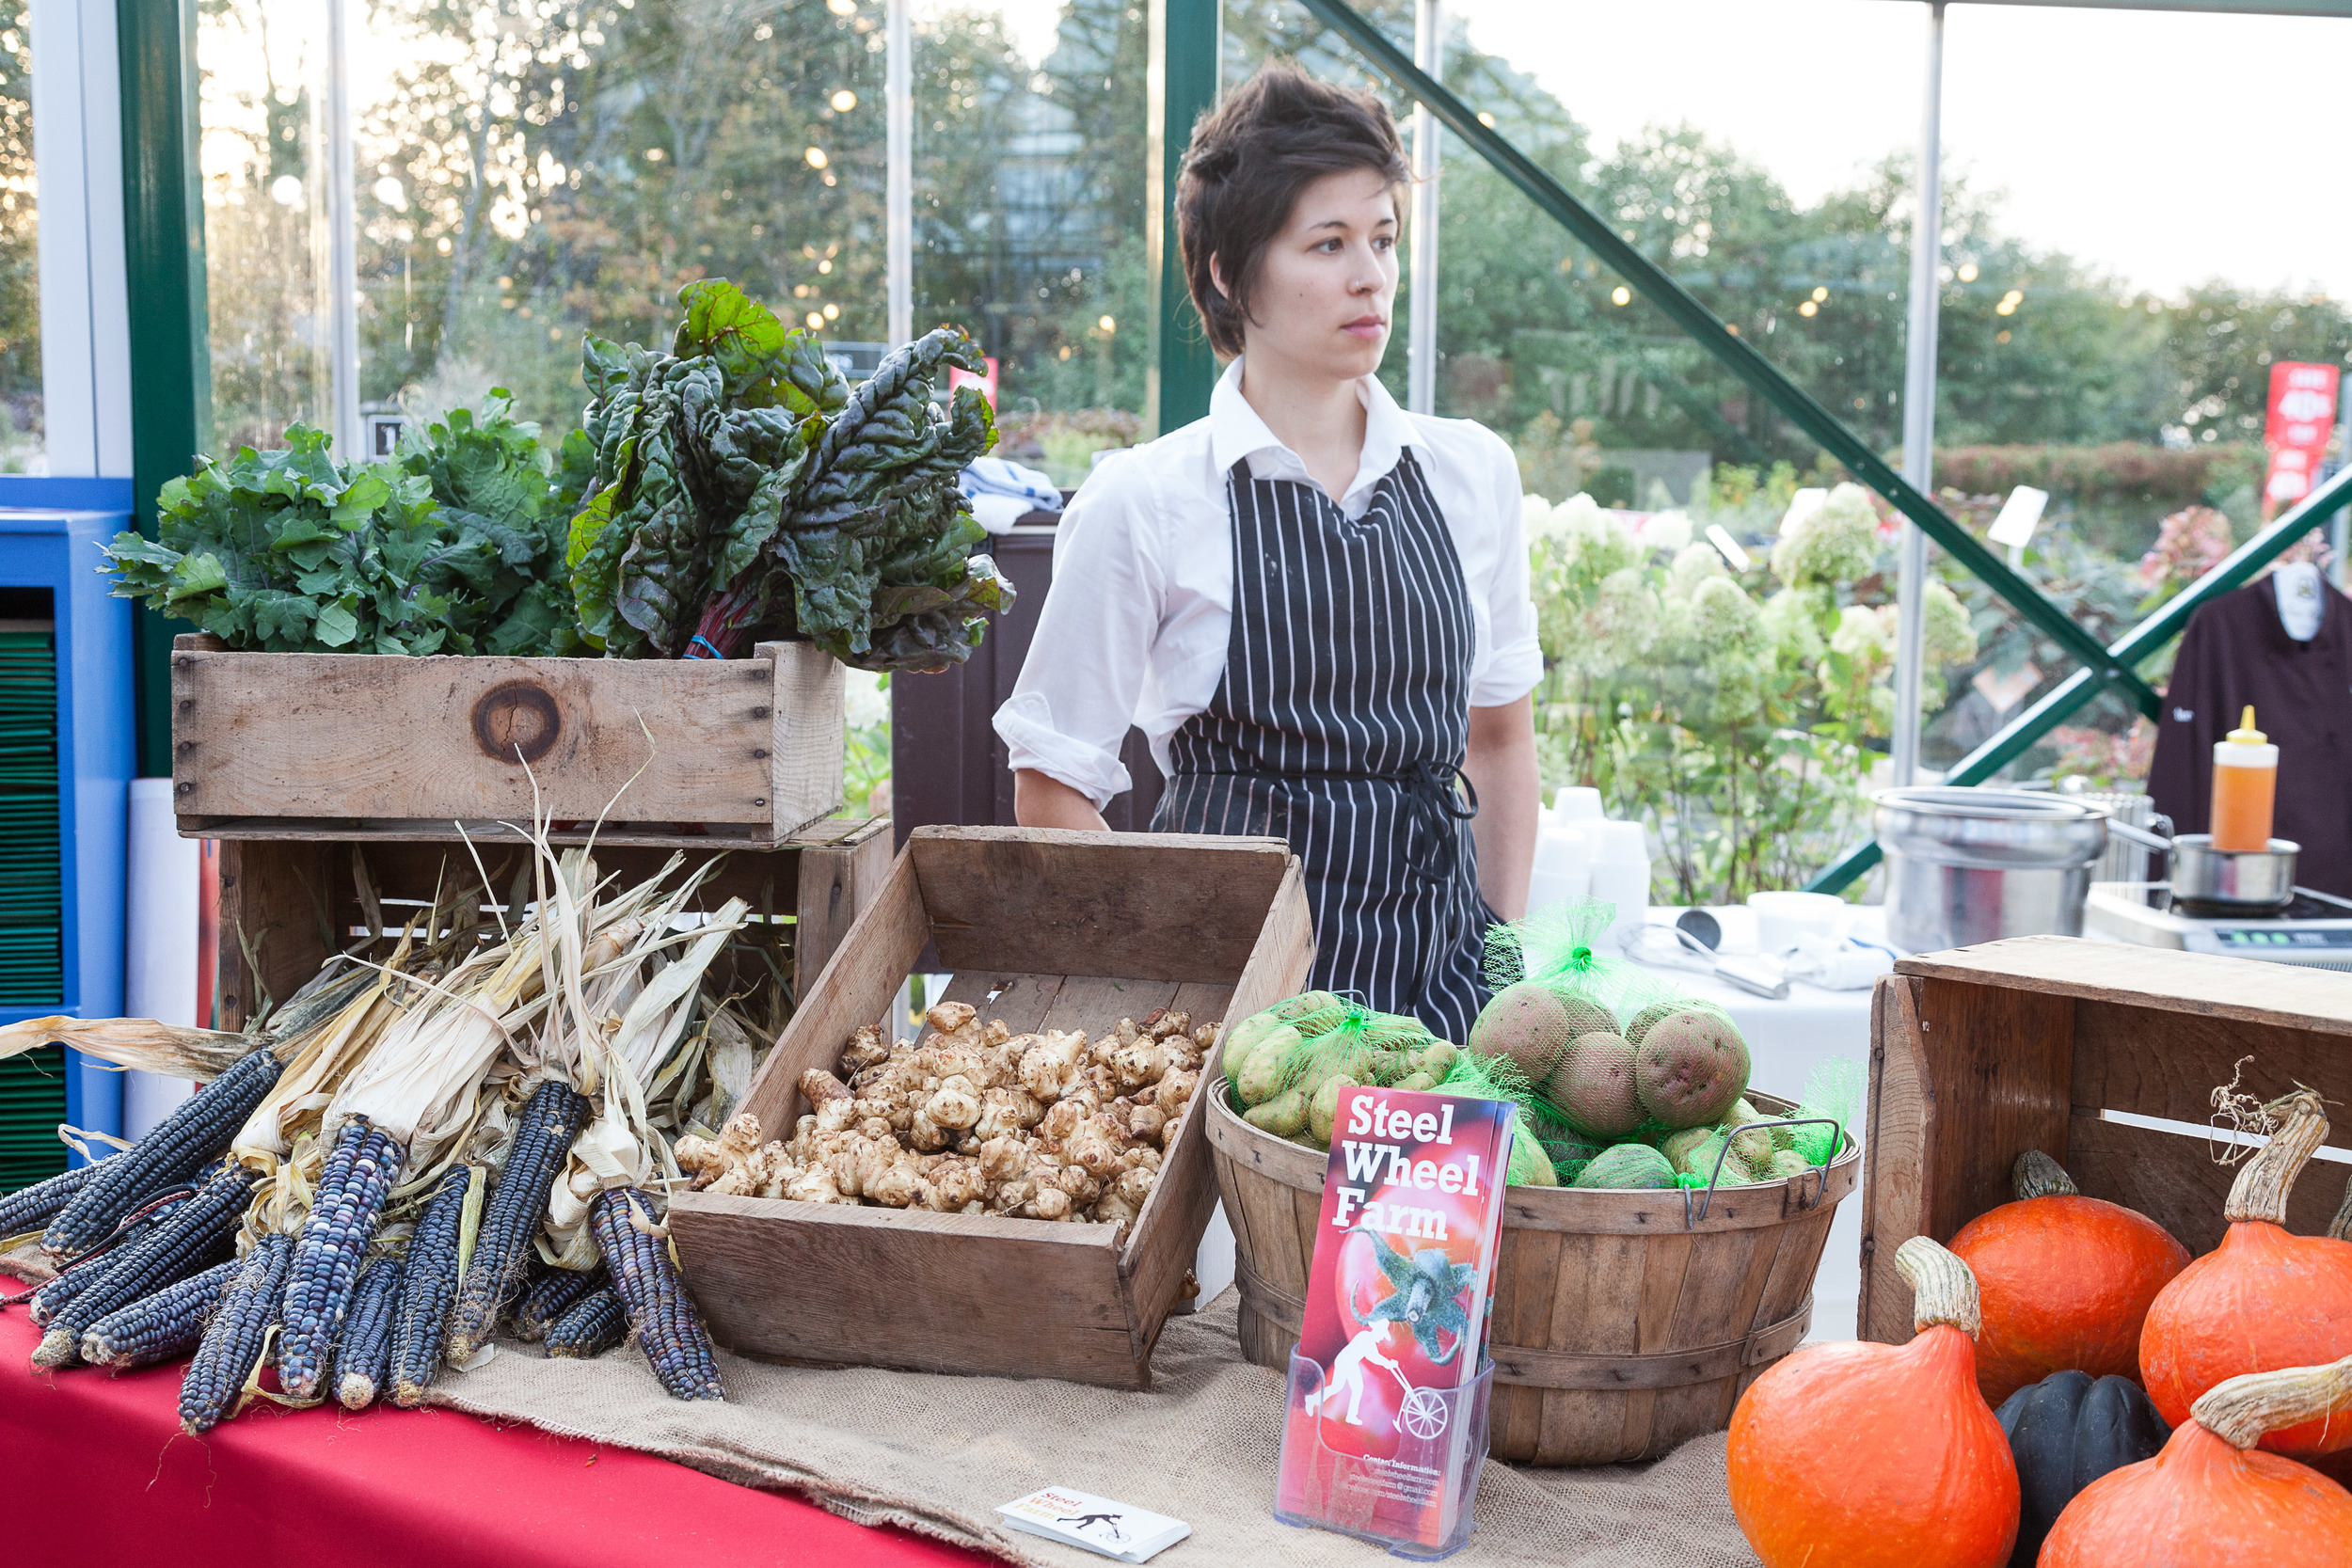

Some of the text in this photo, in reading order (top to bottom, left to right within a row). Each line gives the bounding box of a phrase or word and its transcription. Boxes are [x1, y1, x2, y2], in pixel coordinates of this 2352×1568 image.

[1347, 1094, 1454, 1145] Steel
[1342, 1139, 1480, 1196] Wheel
[1331, 1186, 1449, 1242] Farm
[1363, 1454, 1441, 1476] Contact Information:
[1348, 1473, 1438, 1497] farm@gmail.com
[1013, 1503, 1056, 1520] Farm
[1029, 1497, 1080, 1515] Wheel
[1041, 1493, 1083, 1507] Steel
